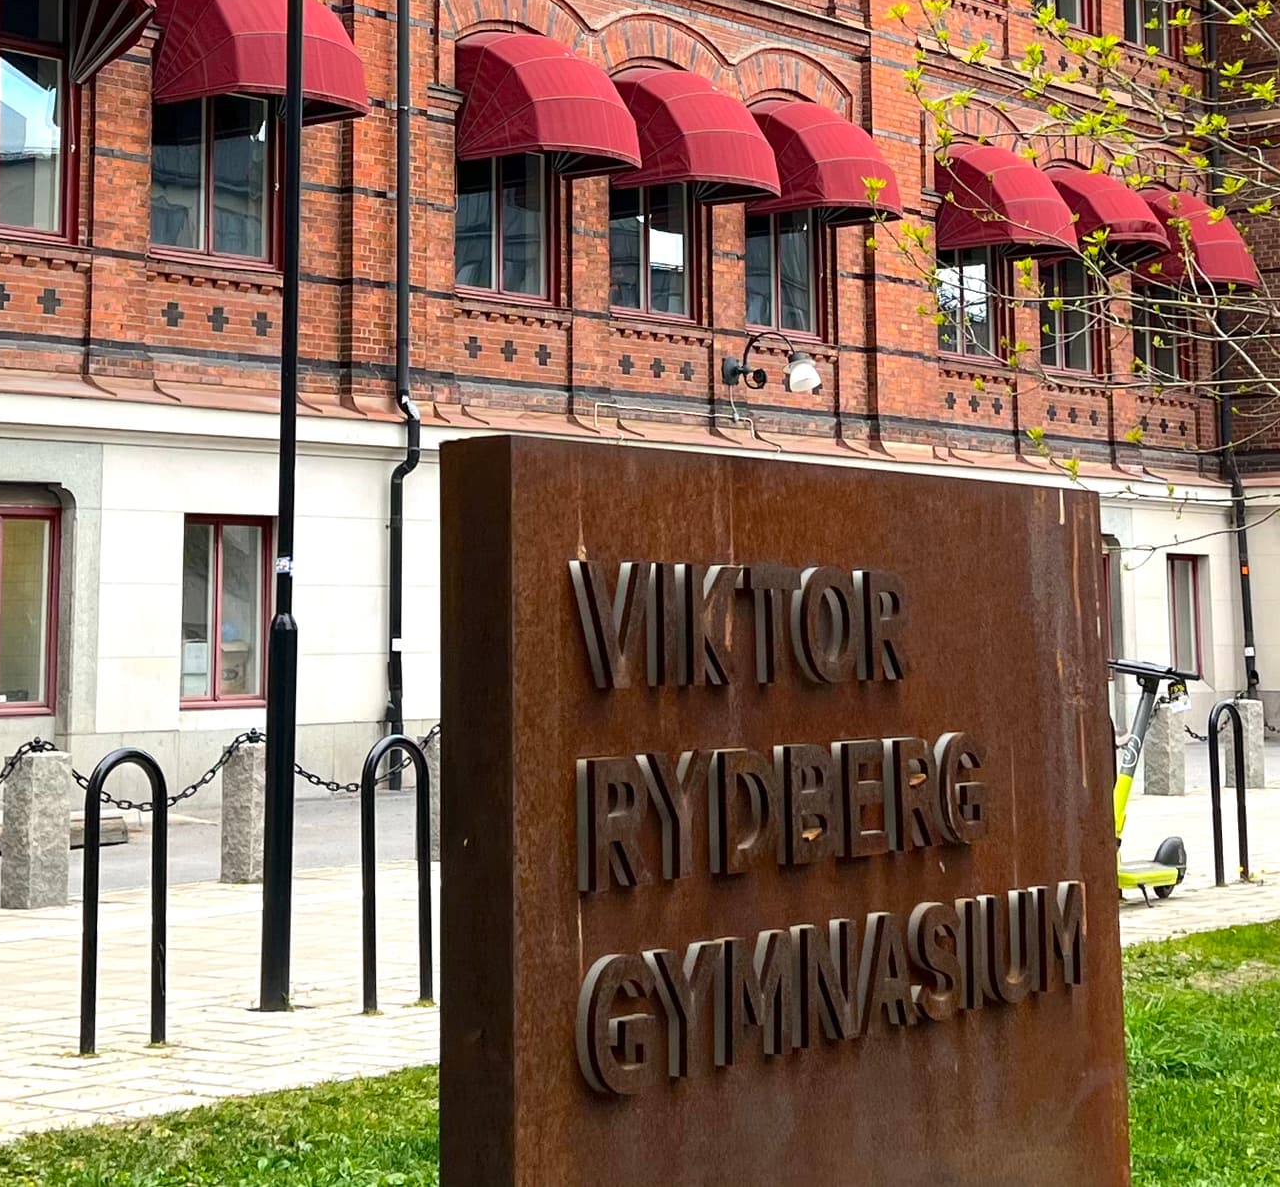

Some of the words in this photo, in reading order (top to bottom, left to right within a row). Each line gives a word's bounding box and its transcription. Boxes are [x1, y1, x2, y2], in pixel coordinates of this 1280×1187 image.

[568, 559, 903, 688] VIKTOR
[576, 731, 984, 891] RYDBERG
[576, 880, 1087, 1095] GYMNASIUM
